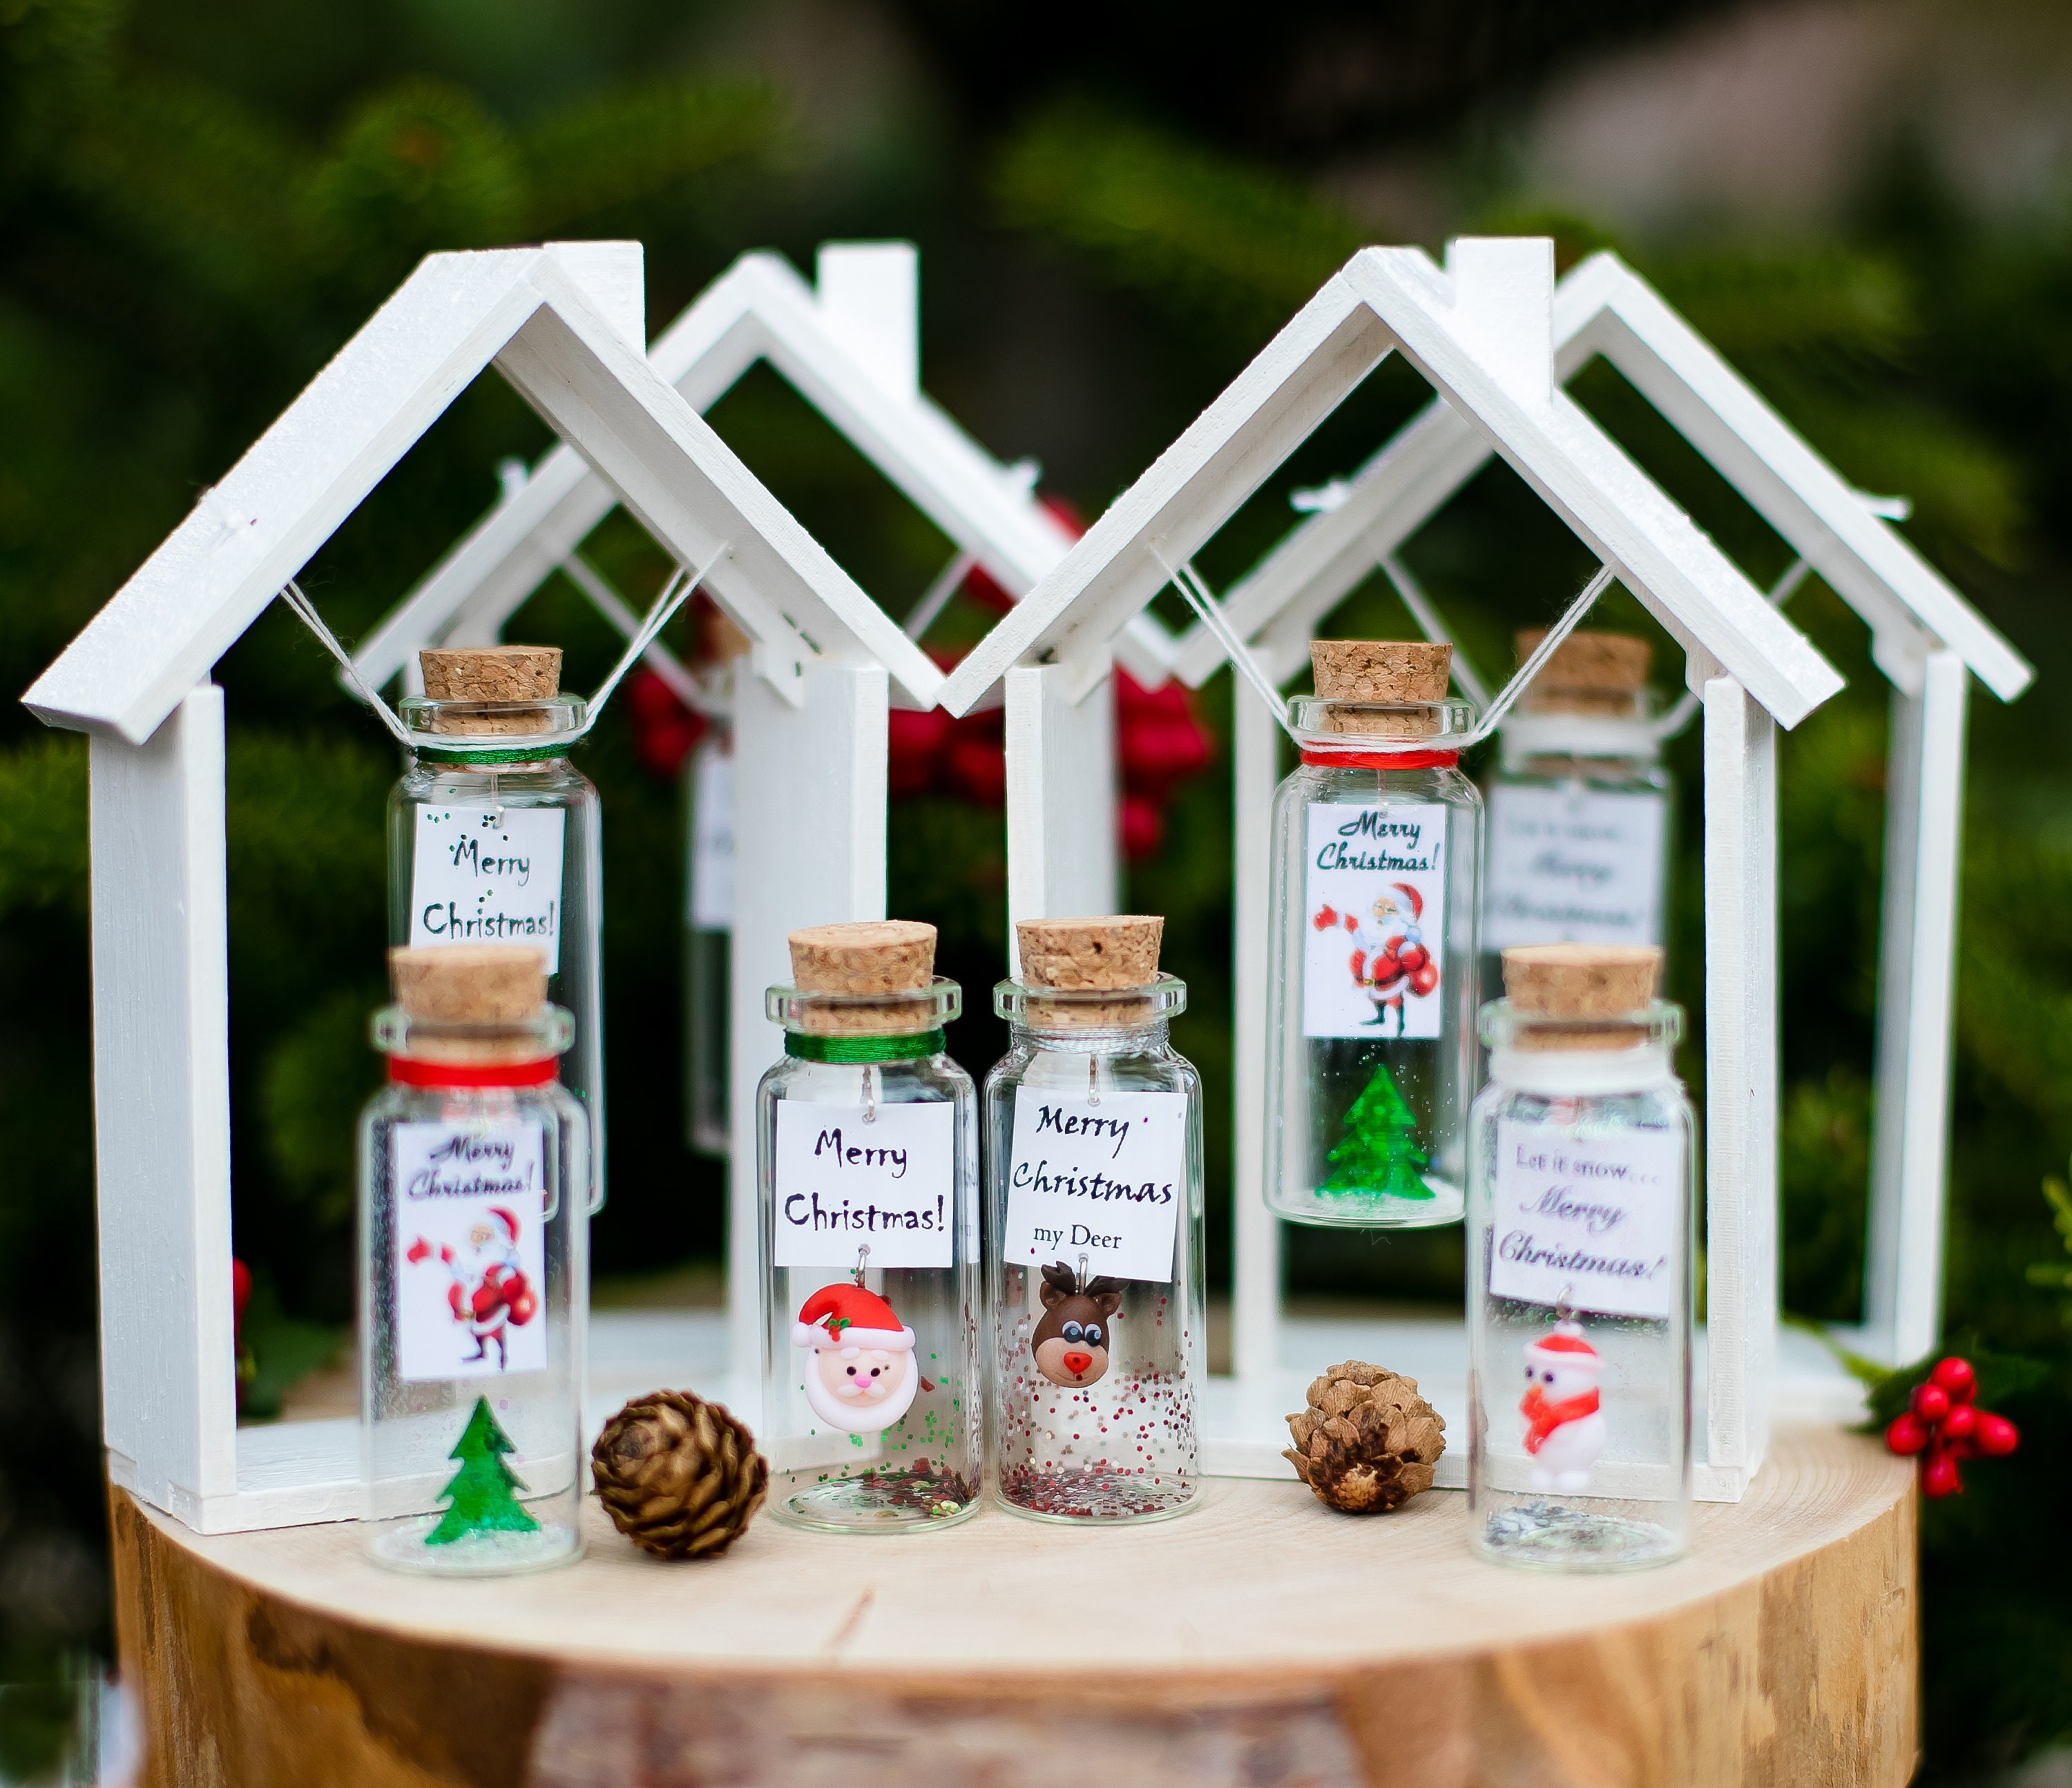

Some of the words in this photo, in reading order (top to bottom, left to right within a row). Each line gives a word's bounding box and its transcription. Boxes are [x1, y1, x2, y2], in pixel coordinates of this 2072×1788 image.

[1337, 810, 1421, 849] Merry
[453, 839, 530, 886] Merry
[1316, 840, 1441, 870] Christmas!
[423, 901, 553, 939] Christmas!
[1036, 1105, 1130, 1159] Merry
[429, 1136, 515, 1170] Merry
[815, 1128, 908, 1178] Merry
[1515, 1143, 1548, 1171] Let
[1554, 1148, 1569, 1173] it
[408, 1162, 534, 1198] Christmas!
[1013, 1160, 1173, 1206] Christmas
[785, 1194, 946, 1232] Christmas!
[1519, 1185, 1627, 1233] Merry
[1033, 1226, 1064, 1250] my
[1070, 1224, 1122, 1249] Deer
[1498, 1229, 1666, 1280] Christmas!
